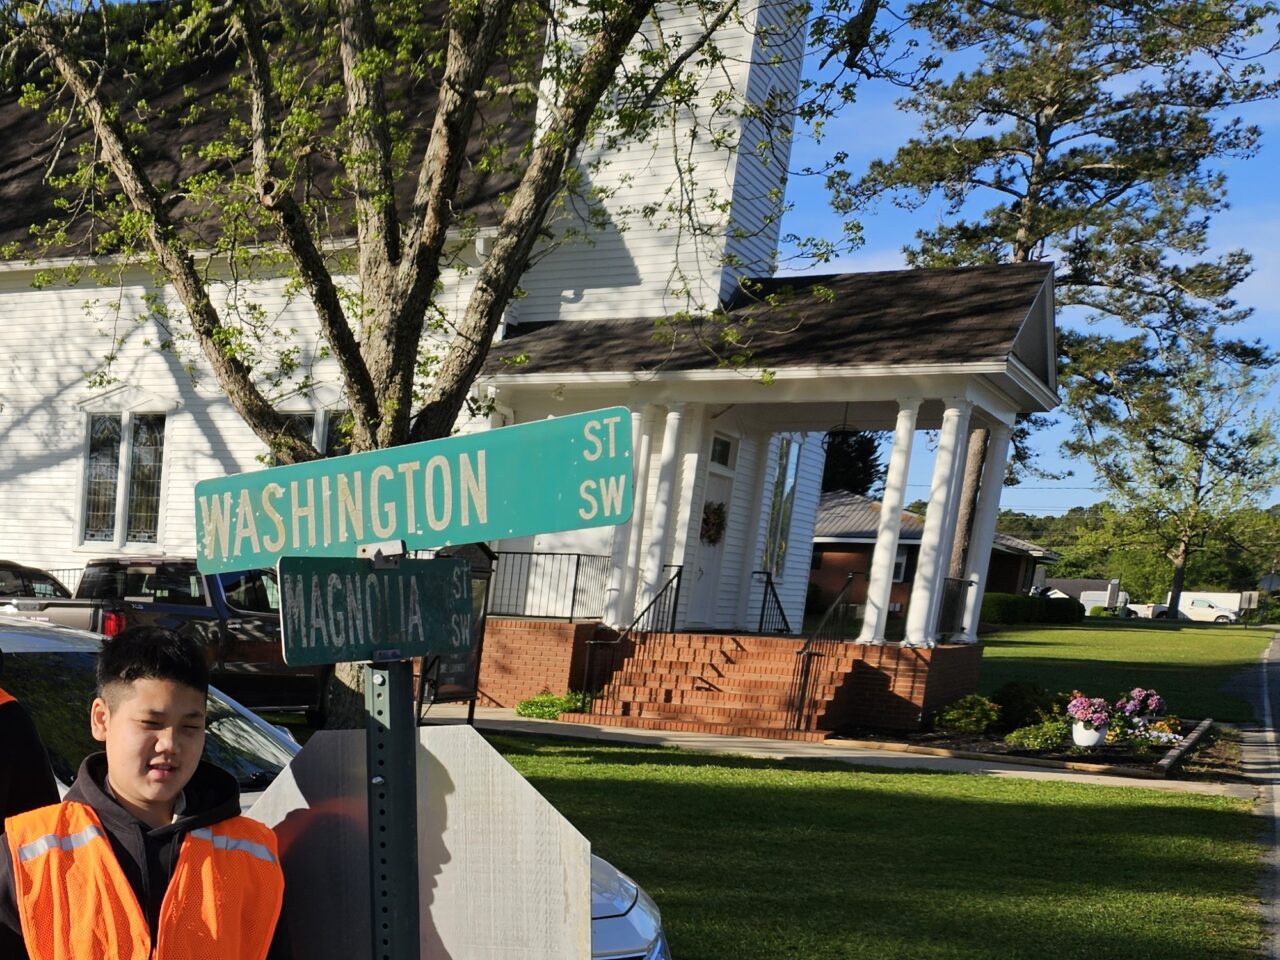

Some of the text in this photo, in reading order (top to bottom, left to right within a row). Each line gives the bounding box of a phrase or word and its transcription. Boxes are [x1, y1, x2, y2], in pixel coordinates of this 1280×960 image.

[199, 450, 487, 560] WASHINGTON
[579, 475, 626, 520] SW
[283, 573, 425, 649] MAGNOLIA
[451, 613, 471, 647] SW
